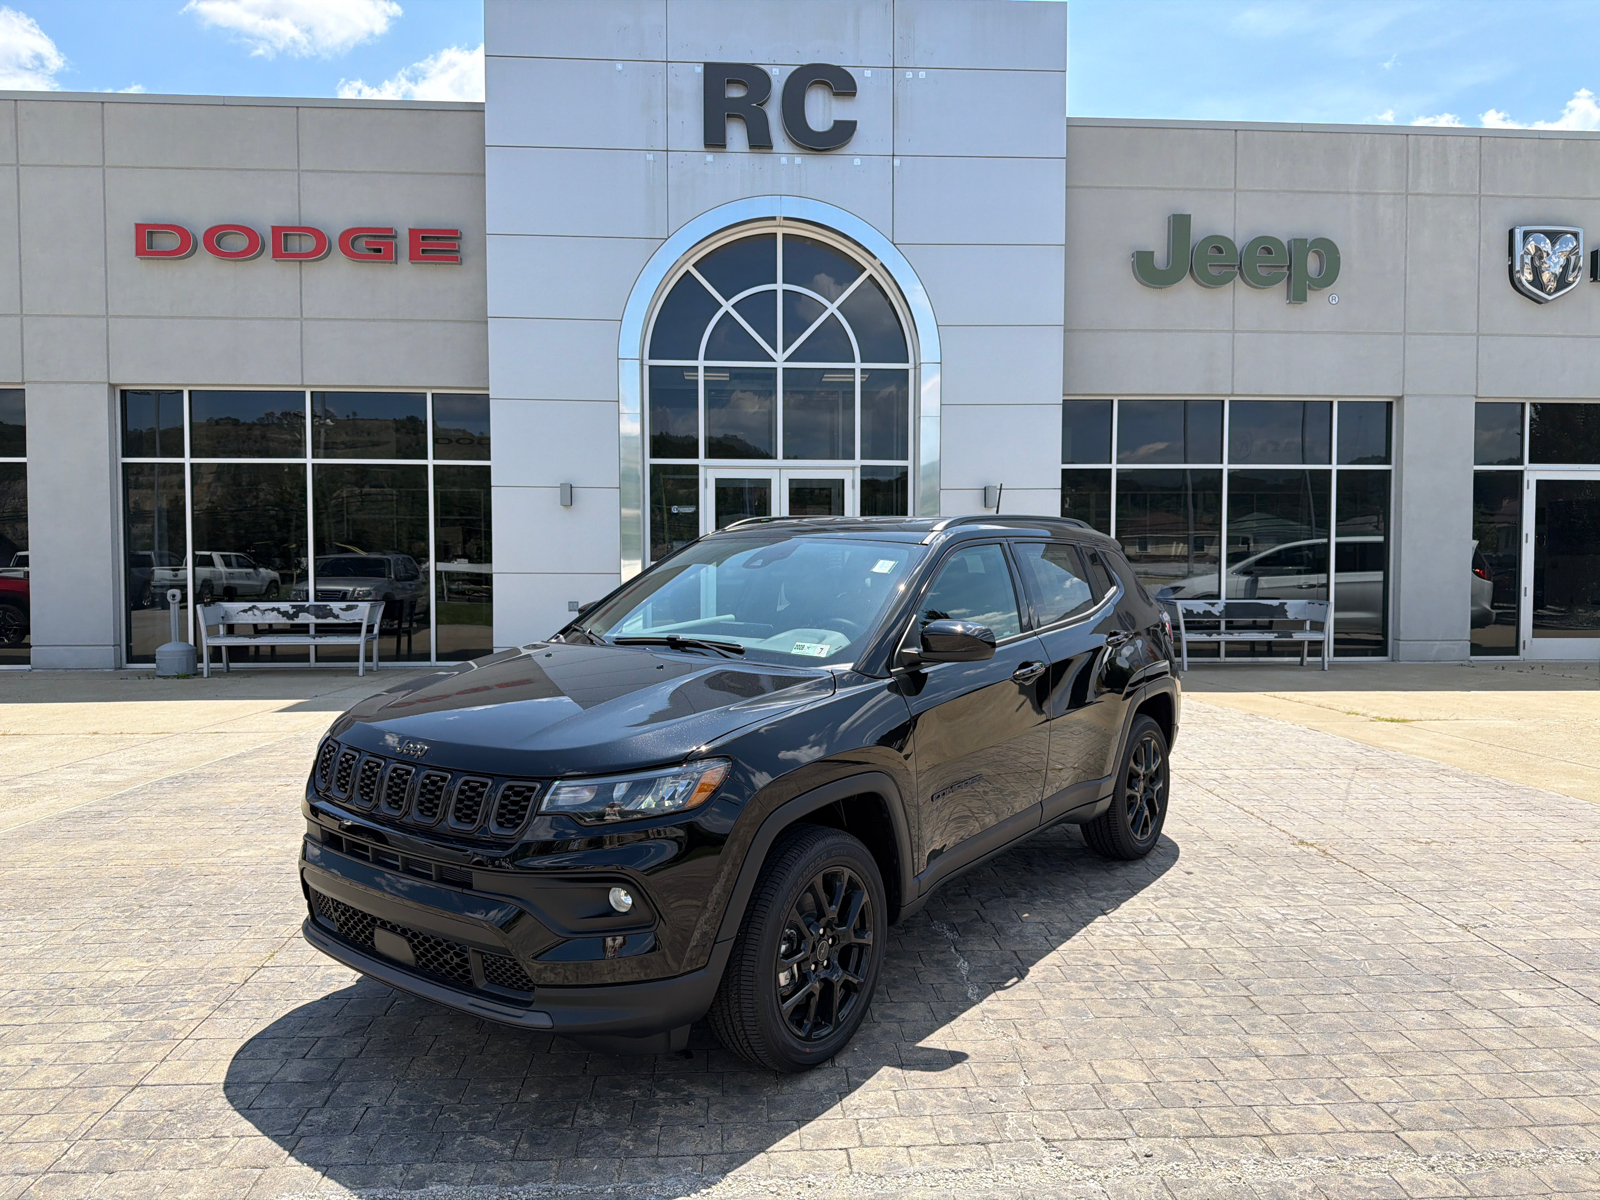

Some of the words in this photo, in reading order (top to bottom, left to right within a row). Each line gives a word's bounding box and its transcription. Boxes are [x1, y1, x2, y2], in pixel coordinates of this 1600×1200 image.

[703, 62, 858, 152] RC
[135, 222, 462, 264] DODGE
[1131, 213, 1341, 304] Jeep
[396, 740, 430, 759] Jeep
